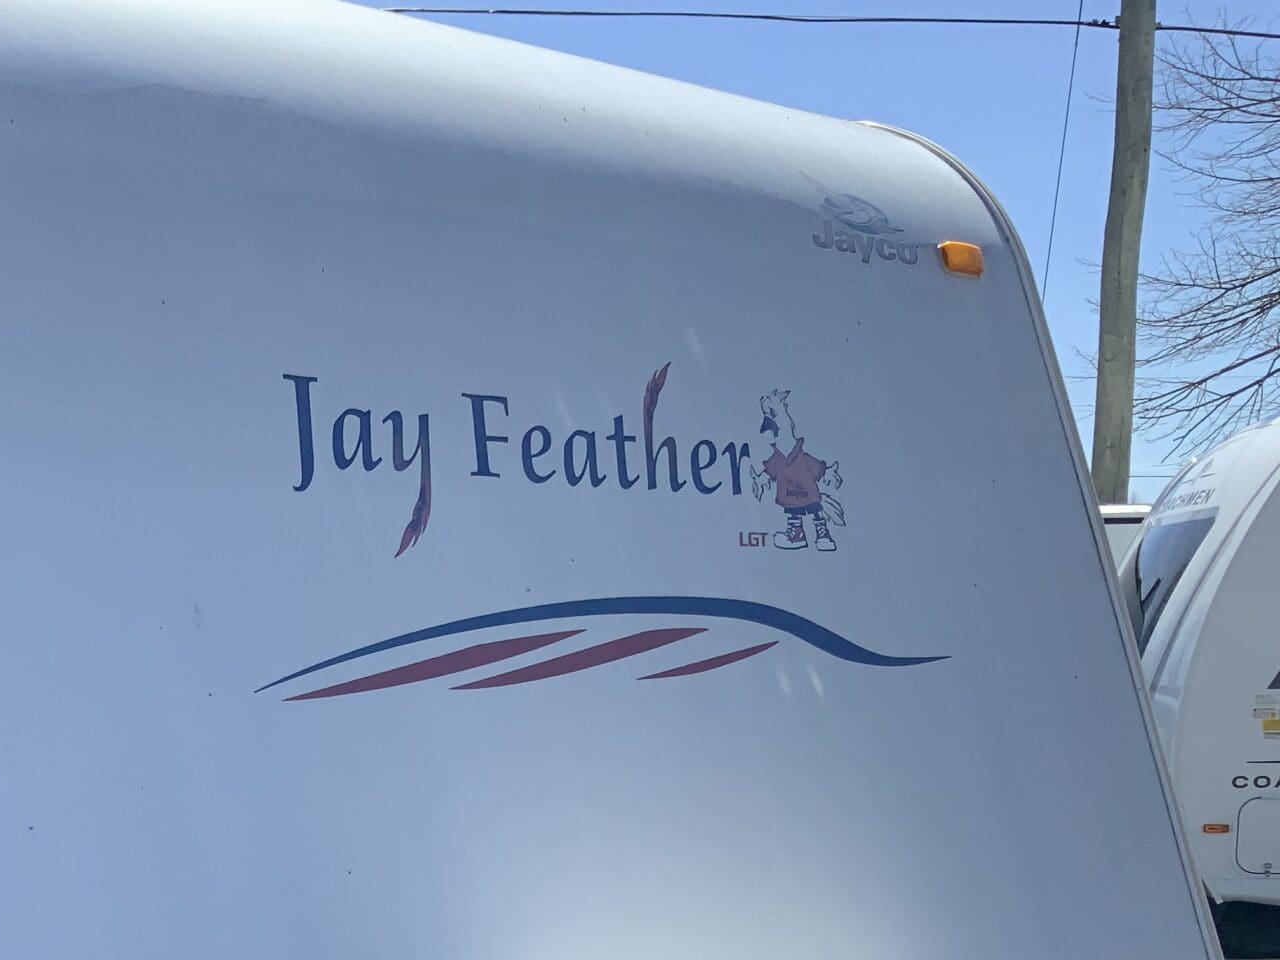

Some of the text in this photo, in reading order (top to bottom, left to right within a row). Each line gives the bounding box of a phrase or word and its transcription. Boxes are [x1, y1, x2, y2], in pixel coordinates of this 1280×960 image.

[811, 218, 920, 265] Jayco
[282, 361, 751, 558] Jay Feather
[739, 531, 769, 547] LGT
